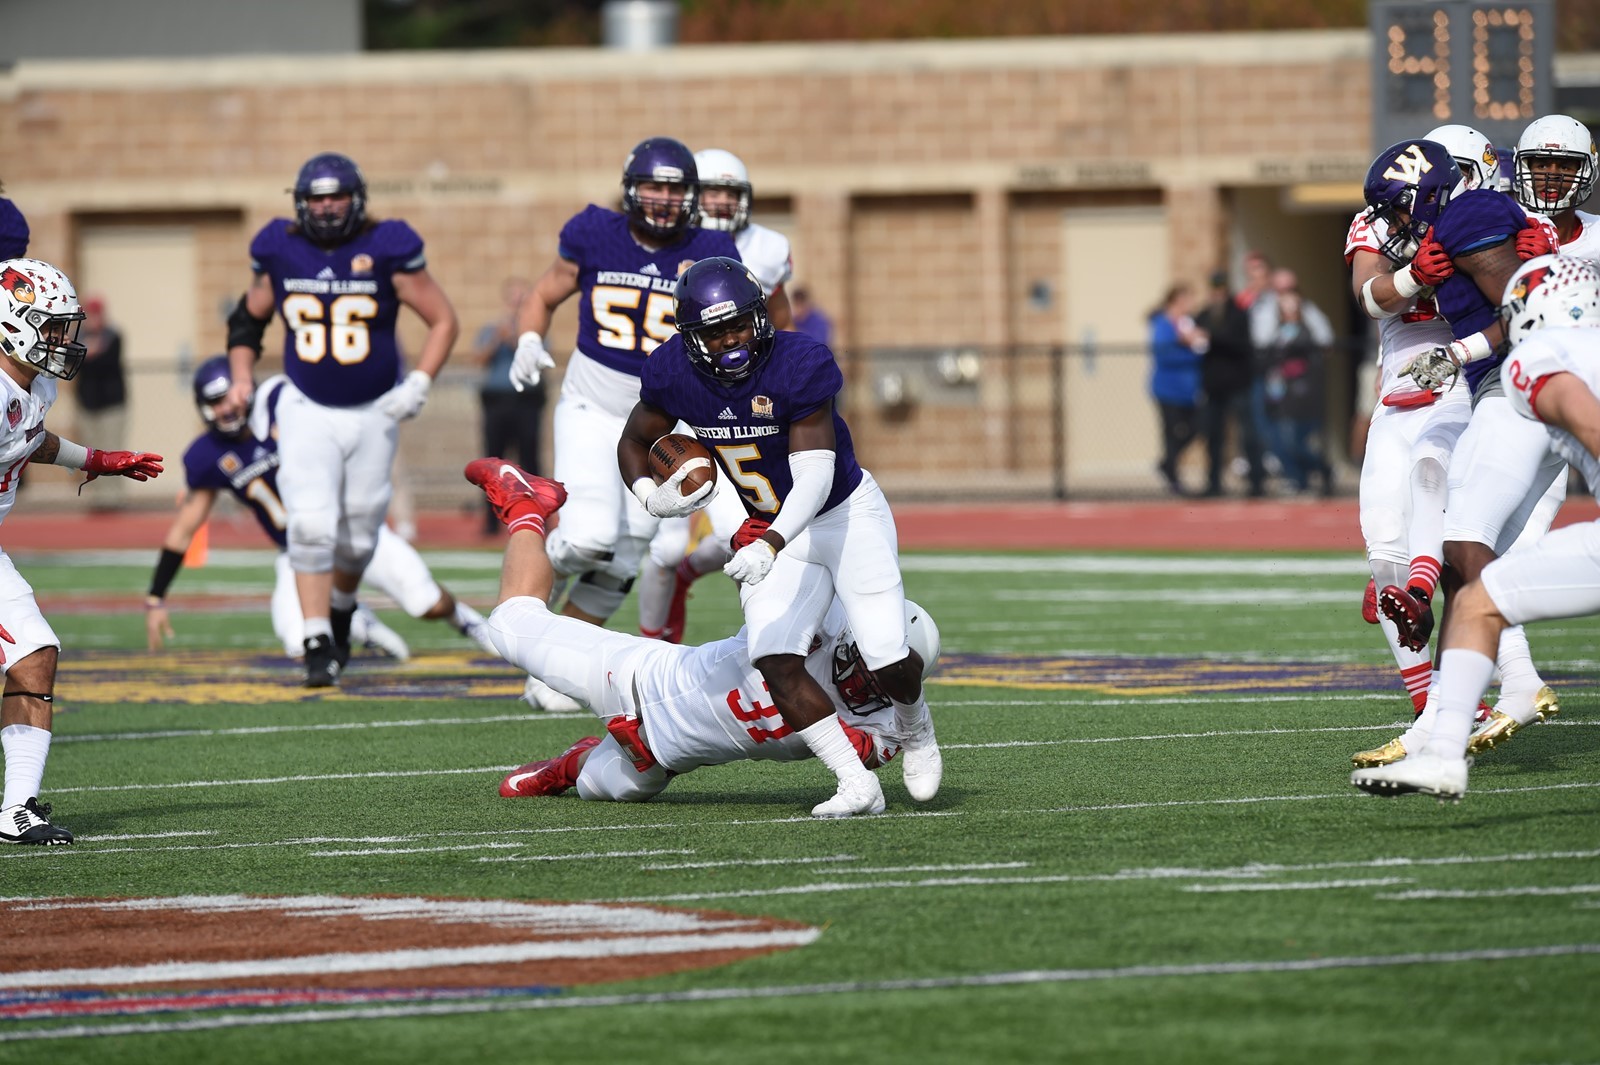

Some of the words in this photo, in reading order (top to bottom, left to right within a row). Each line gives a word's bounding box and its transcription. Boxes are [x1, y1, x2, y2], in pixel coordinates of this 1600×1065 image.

[1388, 8, 1535, 121] 40
[1382, 143, 1434, 185] W
[596, 270, 651, 289] WESTERN
[282, 293, 379, 366] 66
[591, 285, 679, 357] 55
[732, 425, 781, 440] ILLINOIS
[714, 443, 781, 514] 5
